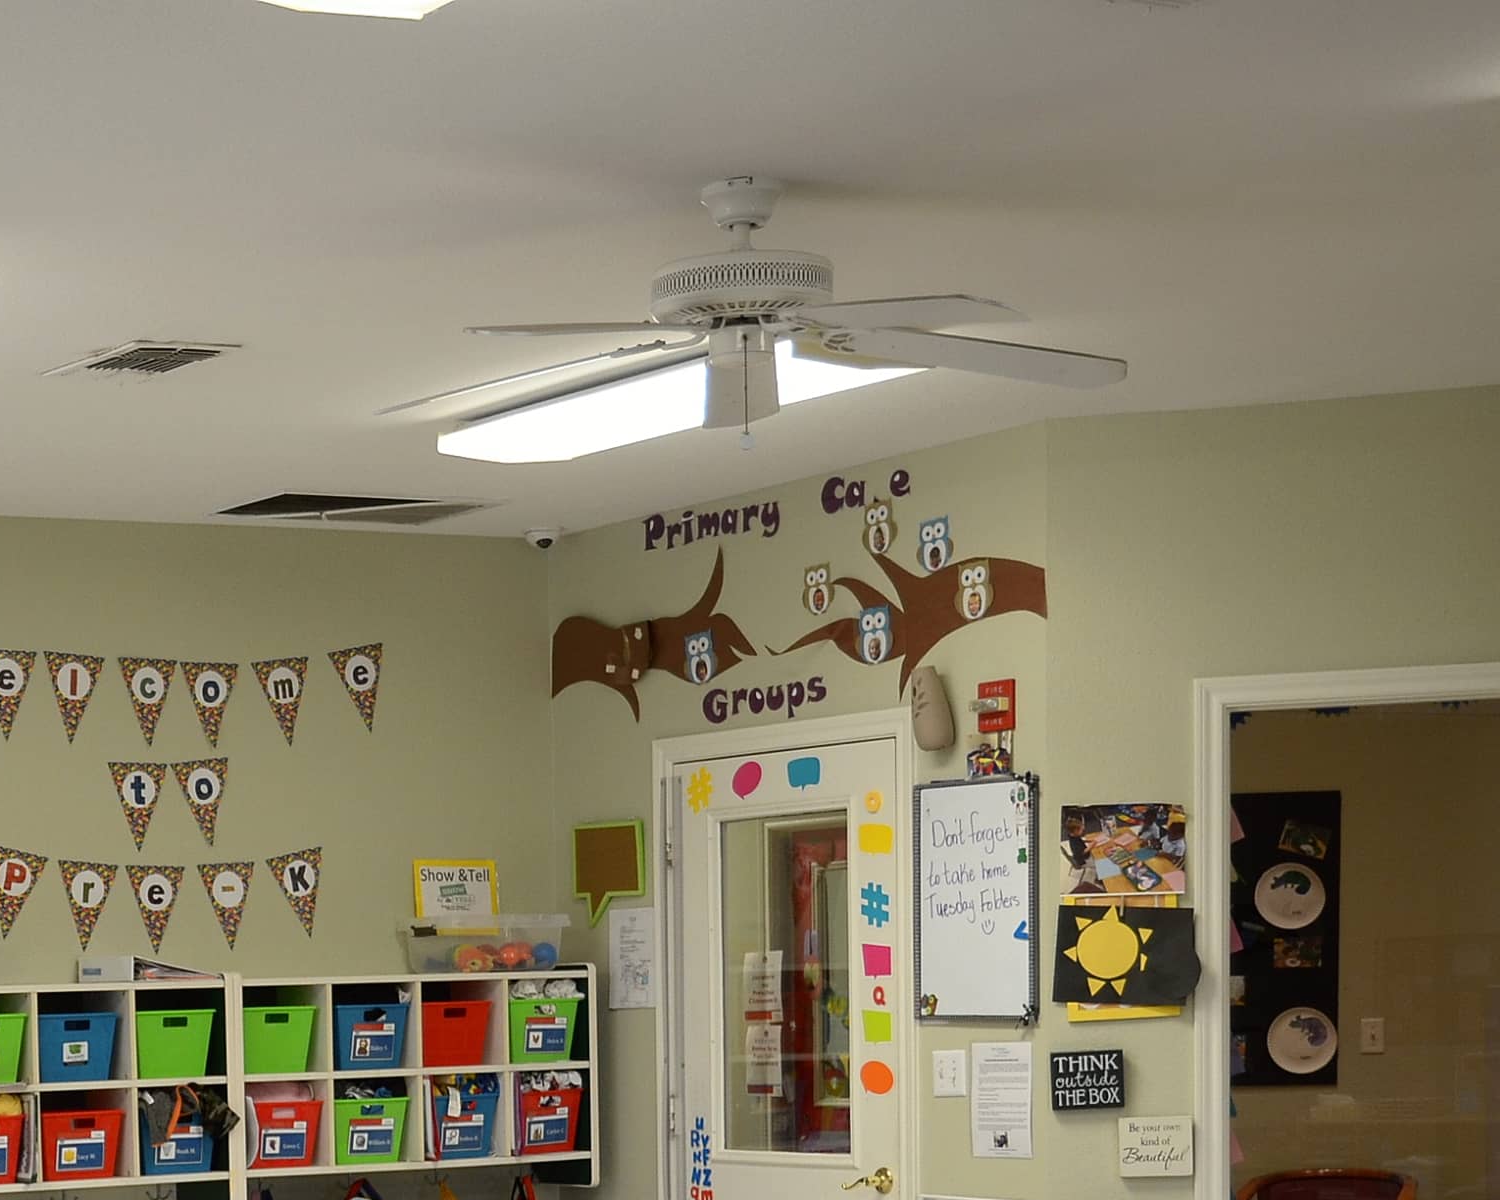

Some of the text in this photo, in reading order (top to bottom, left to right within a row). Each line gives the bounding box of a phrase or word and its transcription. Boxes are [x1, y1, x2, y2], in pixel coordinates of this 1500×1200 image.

[643, 470, 910, 550] Primary Cae
[702, 676, 827, 723] Groups
[985, 686, 1004, 694] FIRE
[984, 718, 1003, 726] FIRE
[130, 776, 213, 804] to
[969, 811, 1013, 854] forget
[4, 862, 311, 904] Pre-K
[420, 868, 454, 882] Show
[926, 861, 1011, 887] to take home
[924, 888, 1020, 923] Tuesday Folders
[1053, 1053, 1119, 1073] THINK
[1056, 1070, 1118, 1088] outside
[1055, 1087, 1120, 1106] THE BOX
[1129, 1123, 1140, 1133] Be
[1142, 1124, 1160, 1135] your
[1140, 1135, 1171, 1145] kind of
[1122, 1145, 1190, 1170] Beautiful
